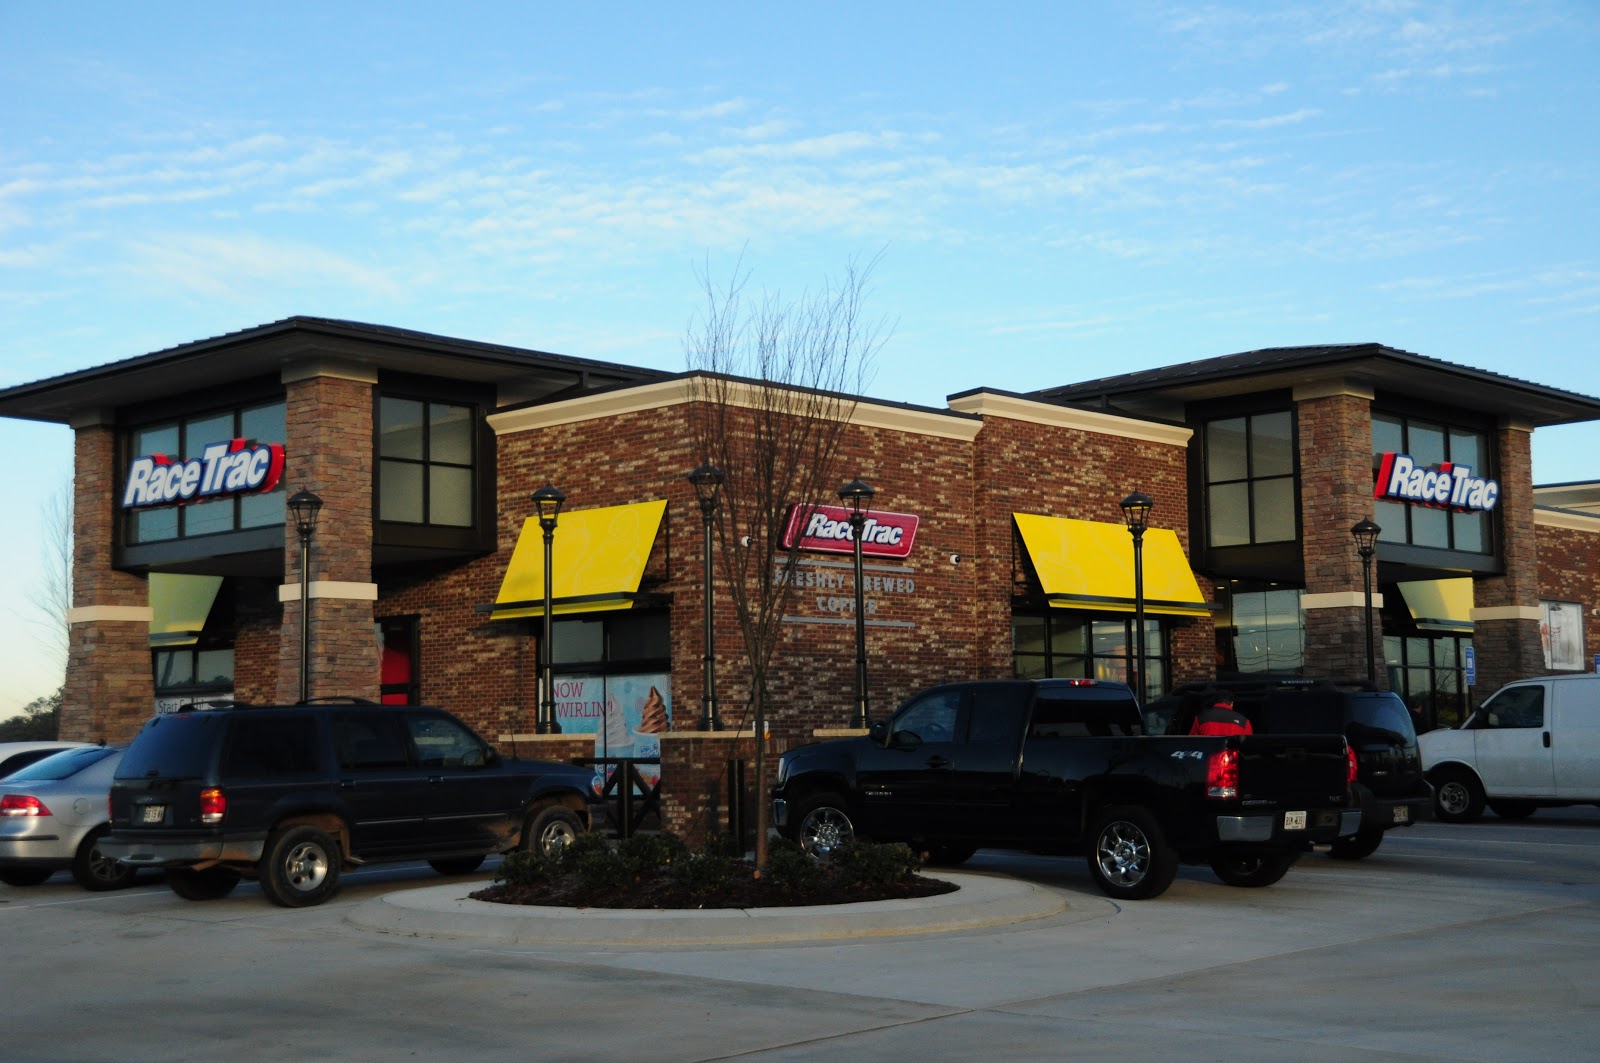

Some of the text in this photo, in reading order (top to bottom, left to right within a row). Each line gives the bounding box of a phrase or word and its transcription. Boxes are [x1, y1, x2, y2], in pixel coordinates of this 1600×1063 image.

[123, 441, 271, 507] RaceTrac
[1386, 453, 1499, 512] RaceTrac
[853, 575, 915, 594] REWED
[817, 596, 876, 614] COFFE
